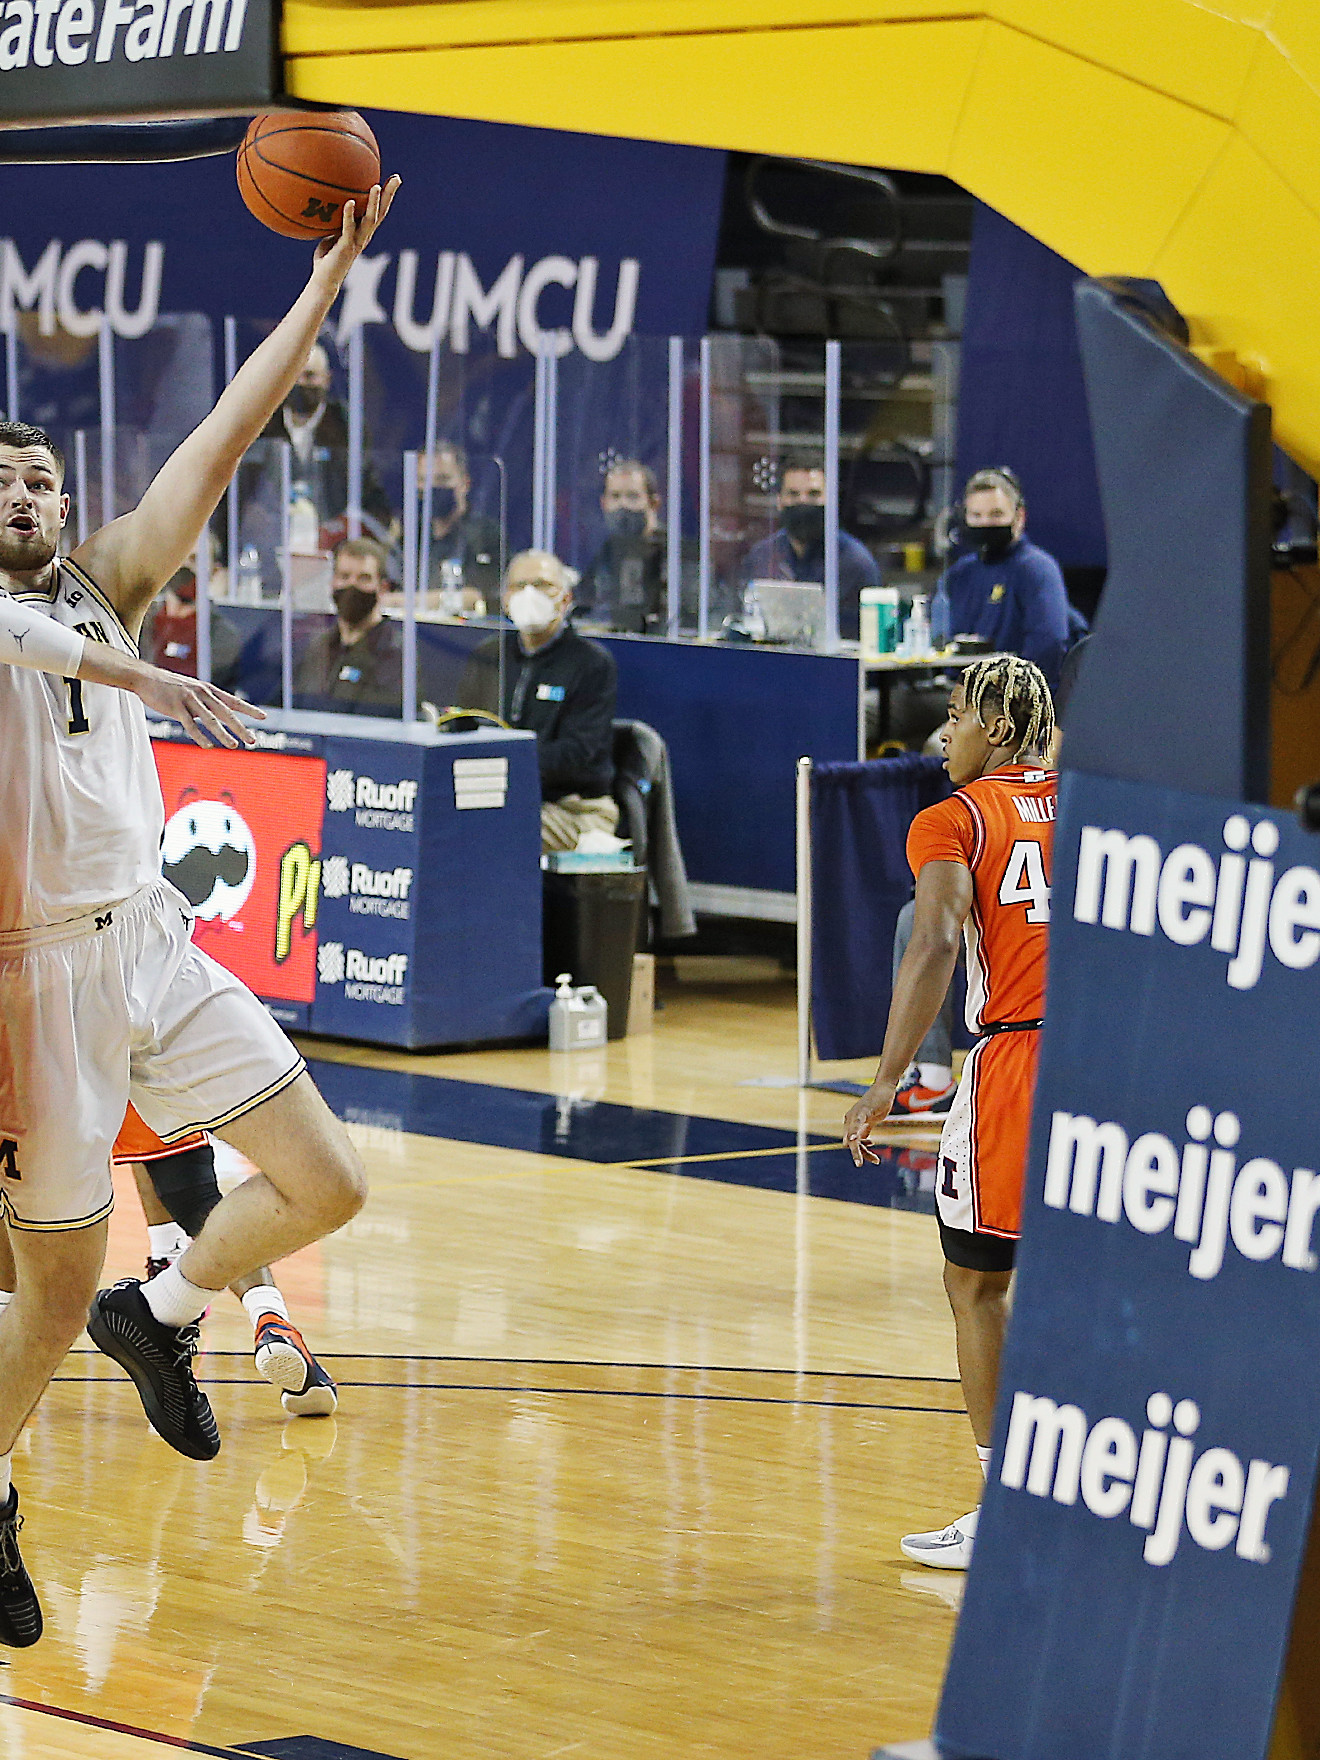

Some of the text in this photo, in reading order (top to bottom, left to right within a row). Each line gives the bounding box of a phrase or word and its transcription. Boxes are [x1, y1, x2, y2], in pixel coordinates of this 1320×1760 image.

[392, 249, 641, 362] UMCU
[63, 675, 91, 736] 1
[356, 776, 418, 812] Ruoff
[1011, 795, 1058, 822] MILLE
[350, 863, 413, 899] Ruoff
[998, 839, 1052, 924] 4
[95, 911, 113, 931] M
[346, 949, 408, 985] Ruoff
[1043, 1105, 1320, 1280] meijer
[999, 1391, 1290, 1566] meijer
